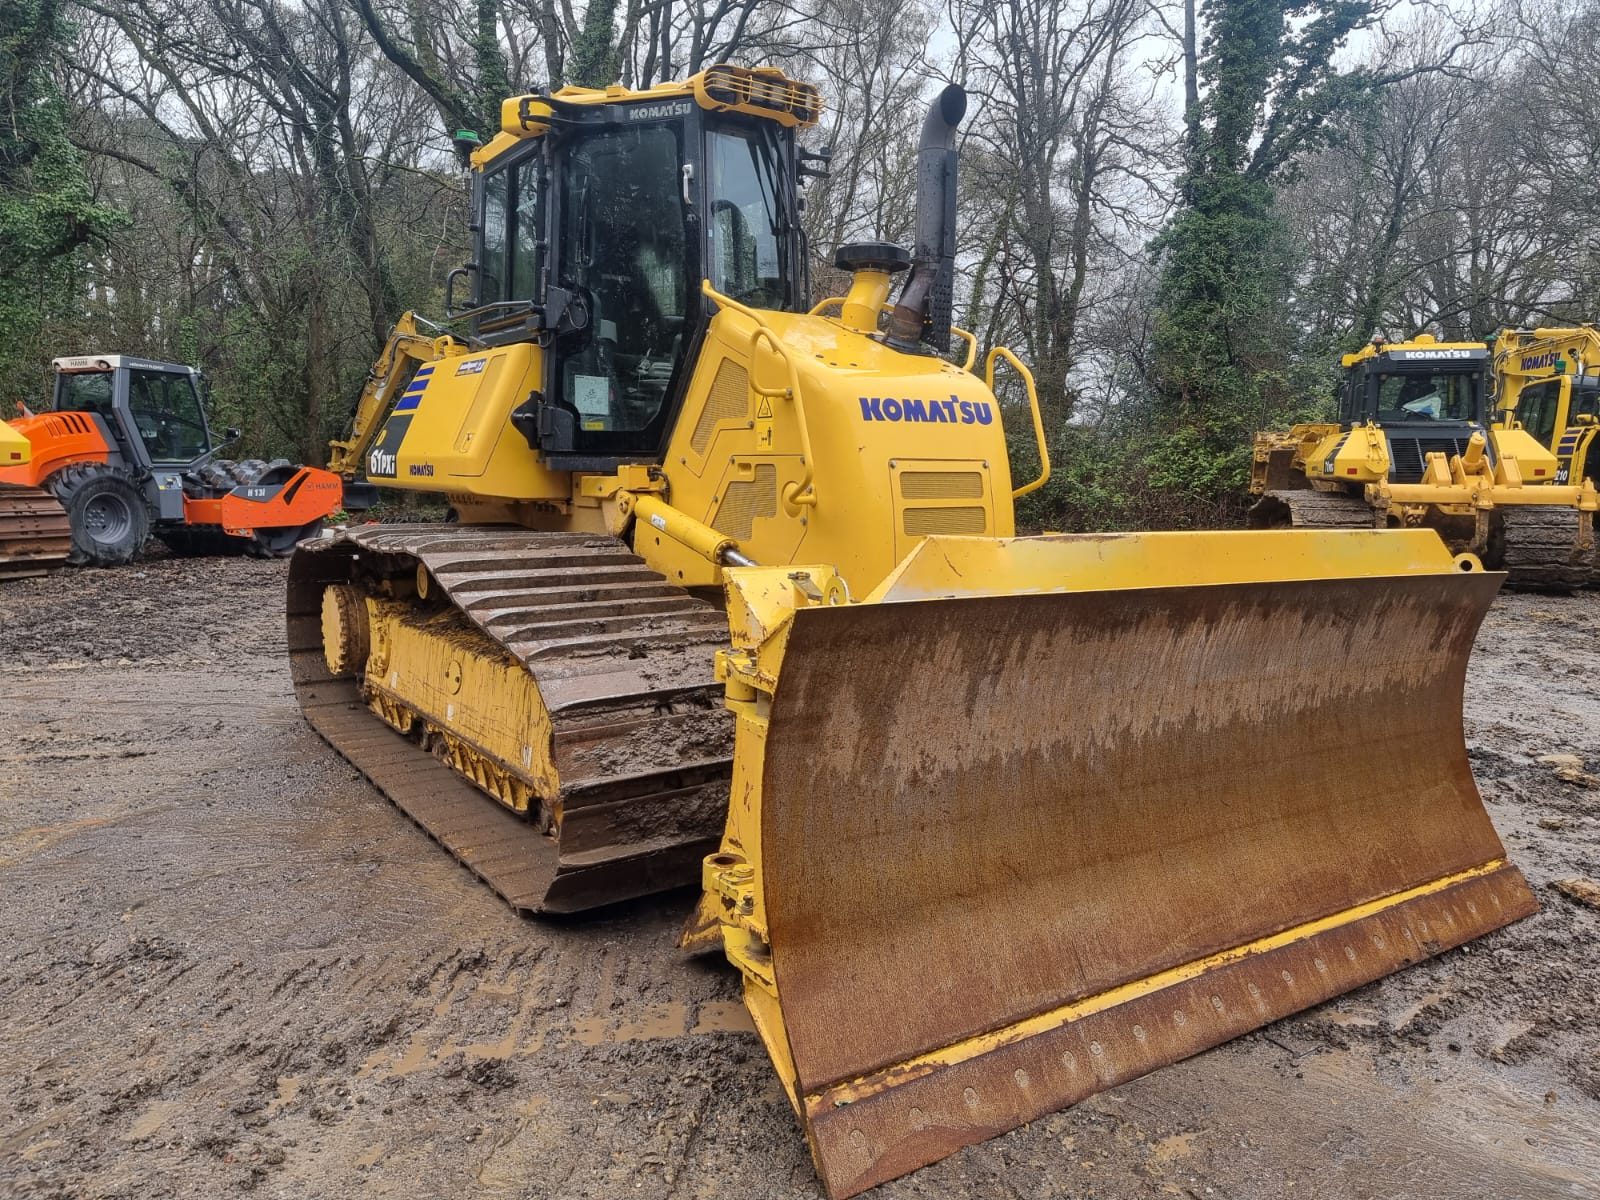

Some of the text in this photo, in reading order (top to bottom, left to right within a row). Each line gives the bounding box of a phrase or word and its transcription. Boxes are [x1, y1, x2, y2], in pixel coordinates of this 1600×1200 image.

[629, 101, 692, 120] KOMATSU
[1405, 349, 1471, 359] KOMATSU
[1520, 350, 1560, 371] KOMATSU
[858, 395, 993, 425] KOMATSU
[370, 449, 395, 475] 61PXi
[409, 461, 434, 476] KOMATSU
